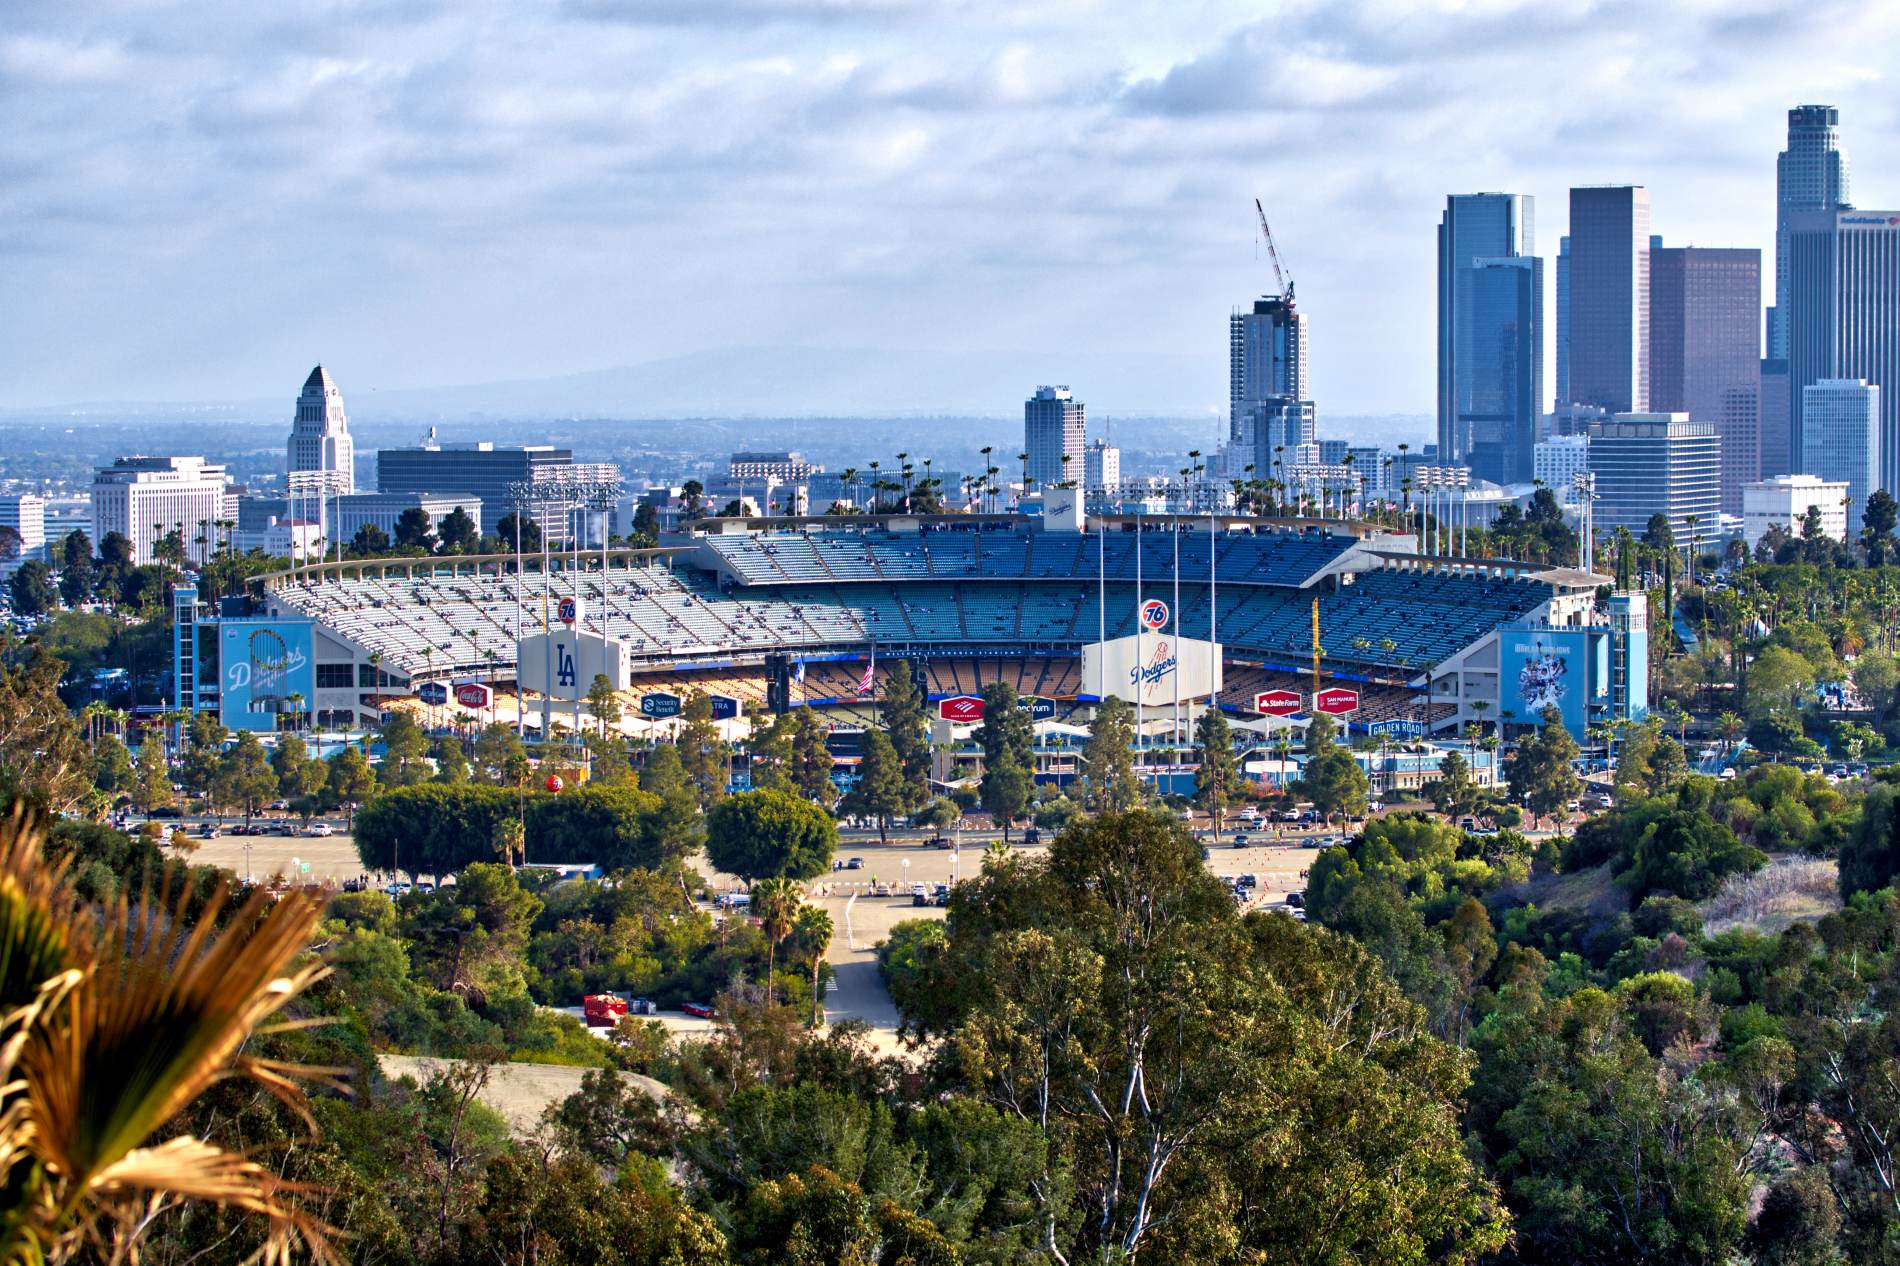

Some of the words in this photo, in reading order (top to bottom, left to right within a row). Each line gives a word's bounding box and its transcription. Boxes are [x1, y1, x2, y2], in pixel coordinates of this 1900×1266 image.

[561, 603, 575, 619] 76
[1145, 605, 1164, 622] 76
[557, 644, 575, 686] LA
[1131, 656, 1178, 685] Dodgers
[656, 699, 678, 707] Security
[1402, 722, 1420, 734] ROAD
